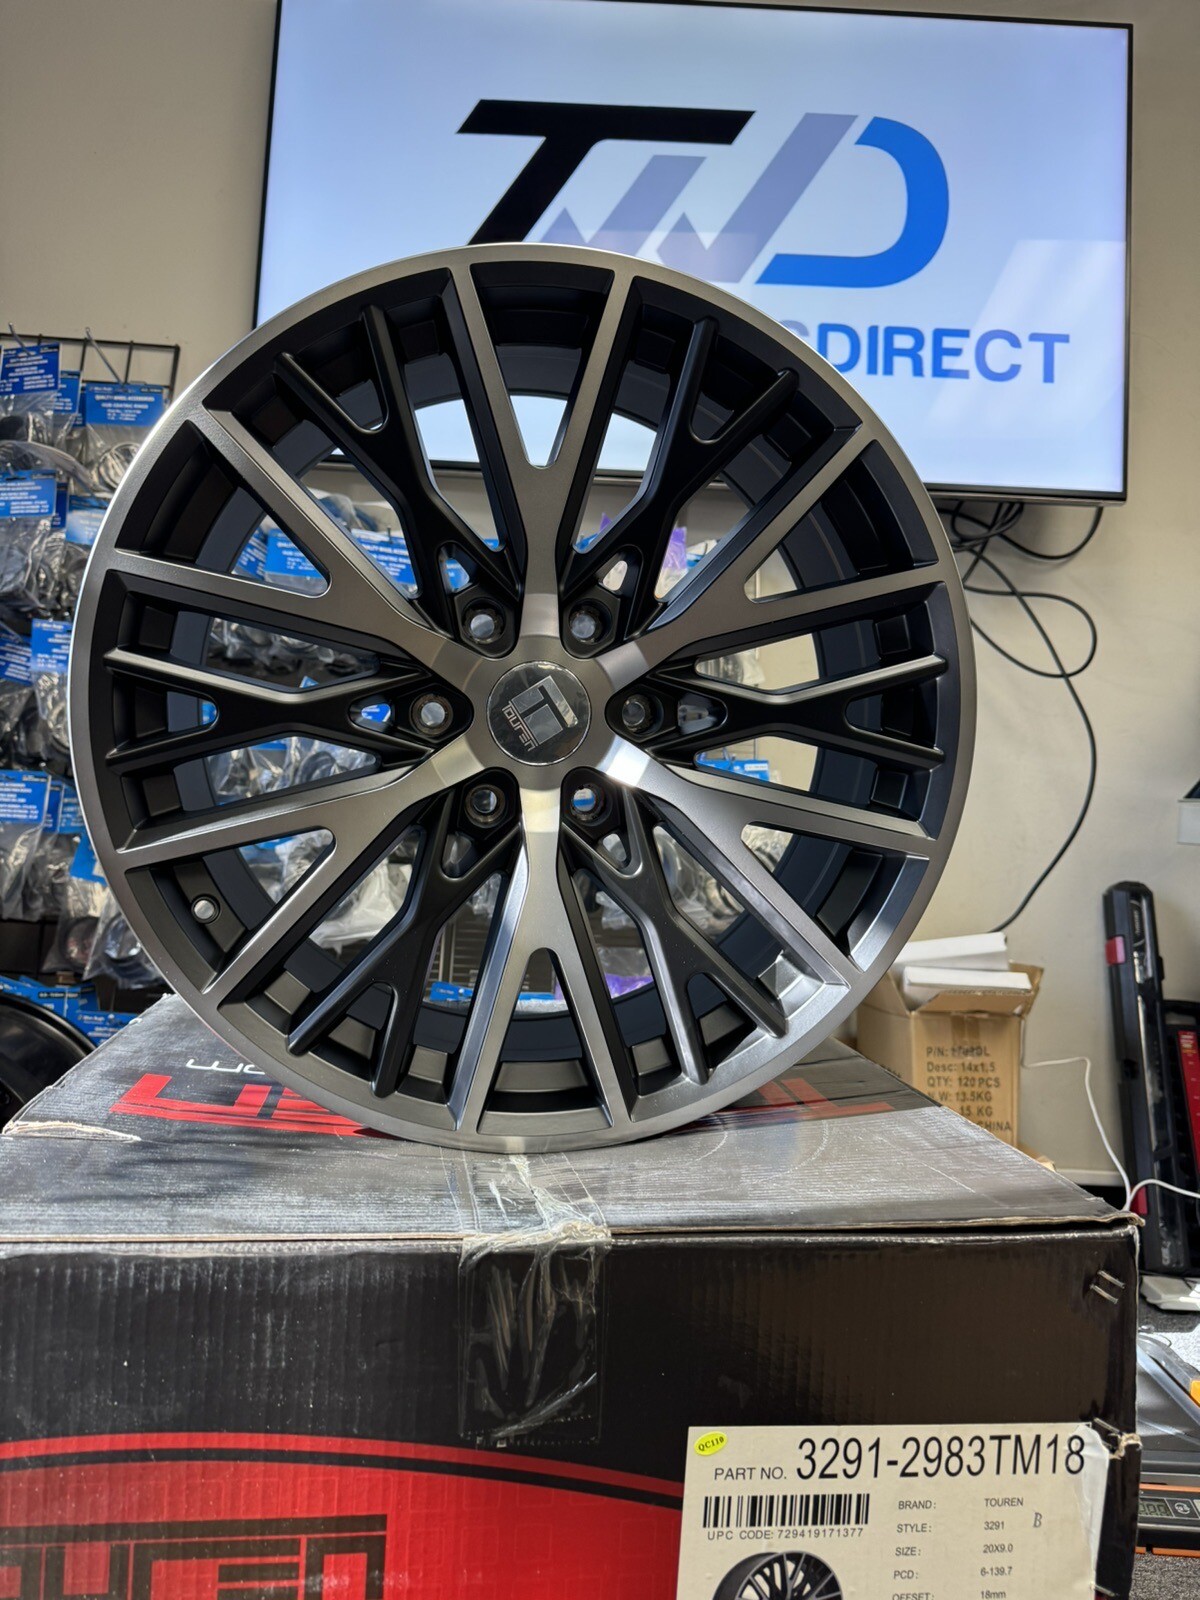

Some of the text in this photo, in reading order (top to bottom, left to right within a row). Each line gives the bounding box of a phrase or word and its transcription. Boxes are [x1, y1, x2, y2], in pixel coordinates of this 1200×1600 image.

[926, 1061, 956, 1072] Desc:
[927, 1076, 952, 1087] QTY:
[698, 1436, 725, 1452] QC110
[714, 1434, 1085, 1480] PART NO. 3291-2983TM18
[898, 1497, 1024, 1510] BRAND: TOUREN
[896, 1520, 1005, 1533] STYLE: 3291
[707, 1527, 864, 1541] UPC CODE: 729419171377
[895, 1543, 1014, 1557] SIZE: 20X9.0
[893, 1566, 1013, 1580] PCD: 6-139.7
[981, 1590, 1006, 1600] 18mm
